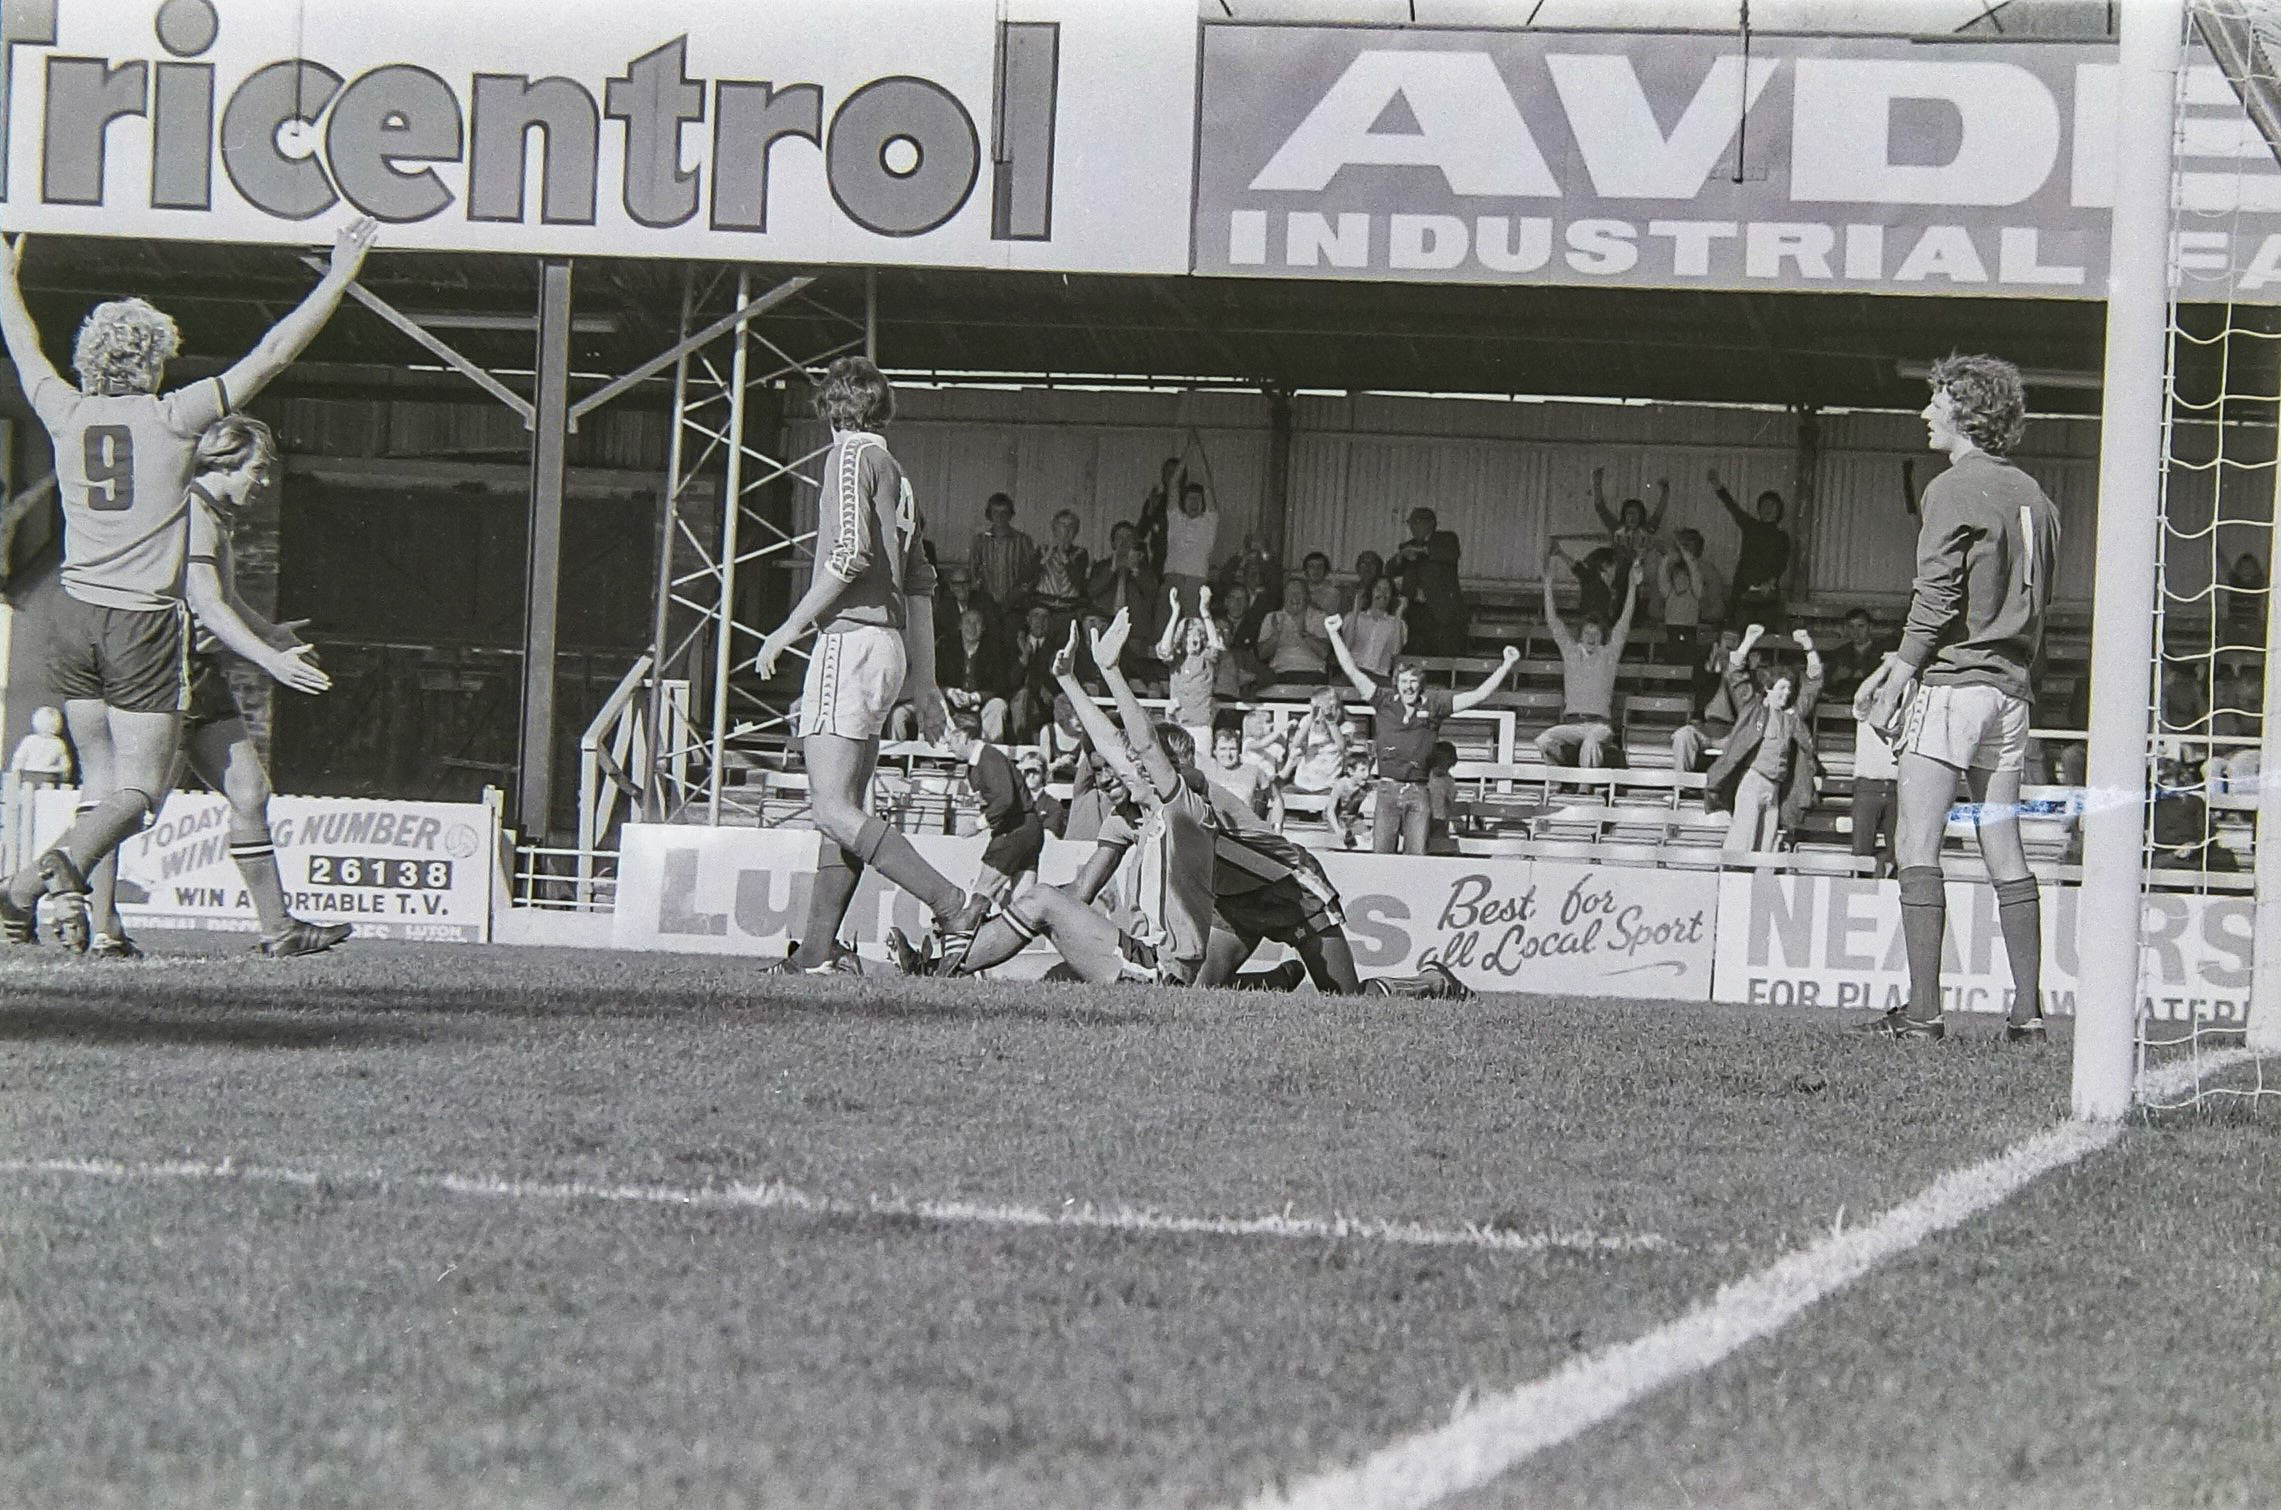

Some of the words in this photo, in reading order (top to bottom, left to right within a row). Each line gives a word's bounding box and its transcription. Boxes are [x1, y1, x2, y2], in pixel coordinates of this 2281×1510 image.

[1229, 210, 2085, 286] INDUSTRIAL
[84, 424, 134, 511] 9
[2019, 505, 2034, 586] 1
[300, 812, 441, 850] NUMBER
[175, 886, 225, 907] WIN
[235, 888, 250, 908] A
[311, 857, 448, 887] 26138
[1561, 873, 1617, 925] for
[1481, 918, 1601, 976] Local
[1608, 904, 1703, 957] Sport
[1748, 978, 1821, 1007] FOR
